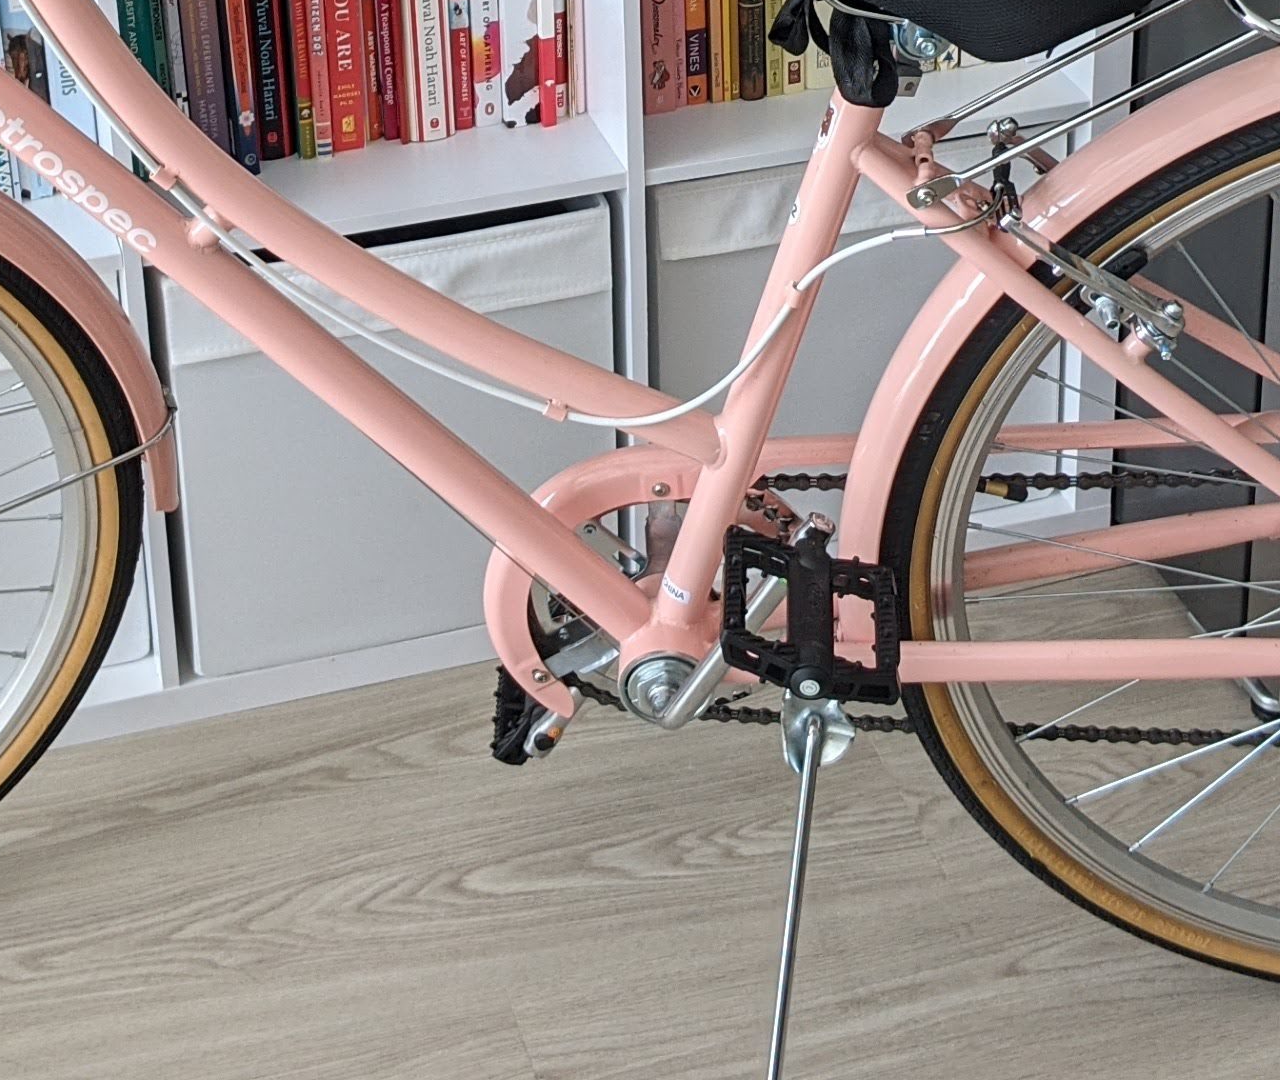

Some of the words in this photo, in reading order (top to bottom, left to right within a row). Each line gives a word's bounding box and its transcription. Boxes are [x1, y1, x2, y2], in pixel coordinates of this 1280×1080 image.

[129, 30, 139, 54] AND
[381, 10, 392, 57] Teaspoon
[424, 25, 438, 61] Noah
[458, 31, 466, 47] ART
[483, 17, 490, 30] OF
[200, 32, 215, 94] EXPERIMENTS
[259, 39, 273, 75] Noah
[312, 32, 323, 56] DO?
[335, 29, 353, 72] ARE
[384, 57, 392, 66] of
[460, 48, 466, 60] OF
[483, 32, 493, 92] GATHERING
[688, 33, 700, 72] VINES
[262, 76, 276, 120] Harari
[384, 66, 394, 105] Courage
[426, 63, 441, 107] Harari
[460, 60, 469, 102] HAPPINESS
